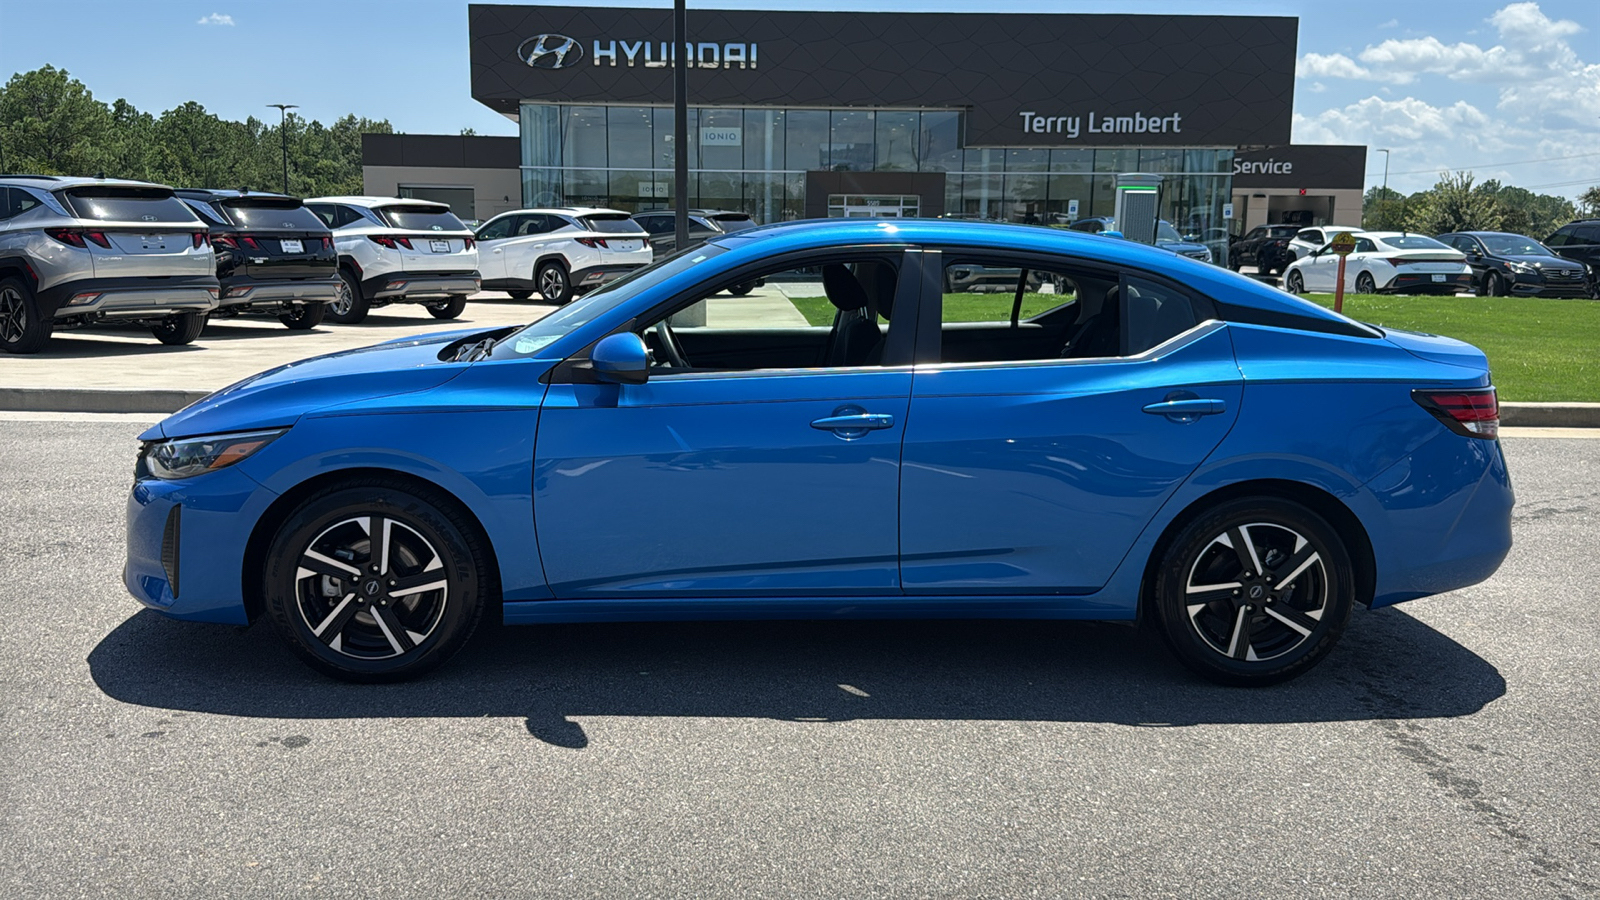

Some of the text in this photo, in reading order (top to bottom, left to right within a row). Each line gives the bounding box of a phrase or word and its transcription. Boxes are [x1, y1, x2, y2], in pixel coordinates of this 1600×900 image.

[593, 40, 758, 69] HYUNDAI
[1019, 111, 1182, 138] Terry Lambert
[705, 132, 737, 141] IONIQ
[1233, 158, 1293, 174] Service
